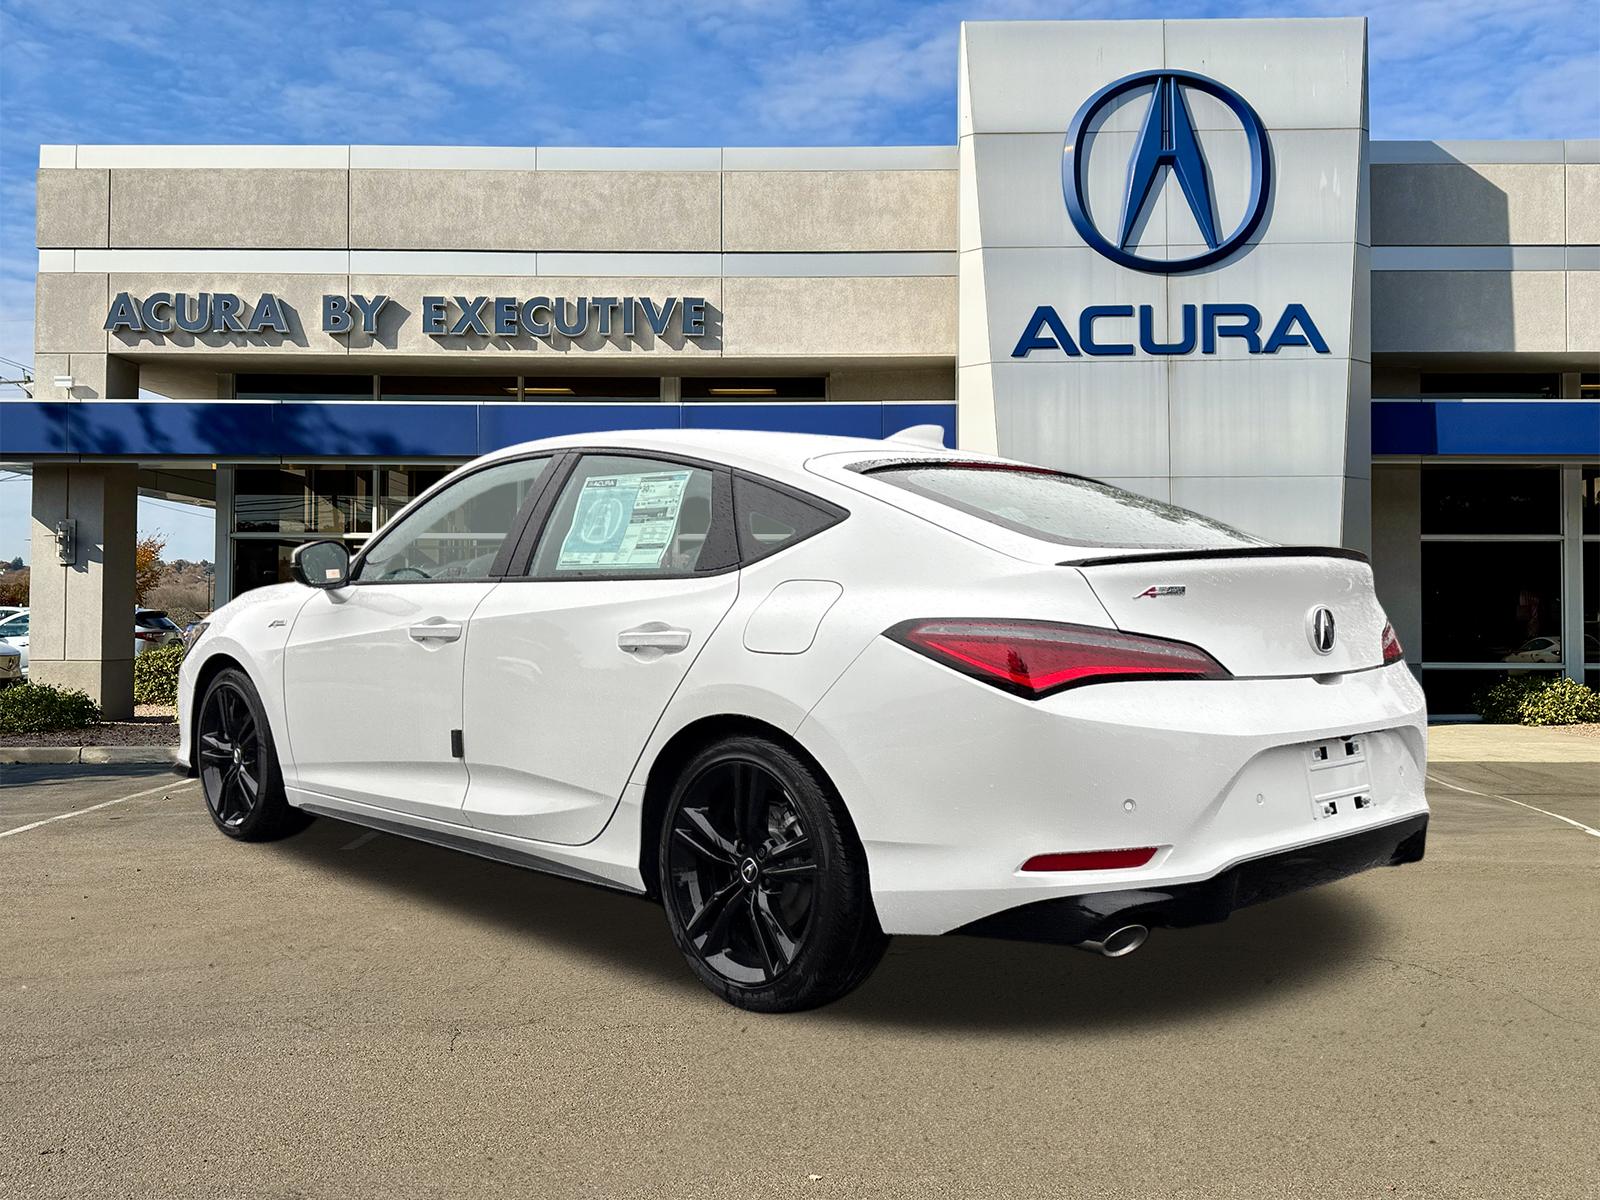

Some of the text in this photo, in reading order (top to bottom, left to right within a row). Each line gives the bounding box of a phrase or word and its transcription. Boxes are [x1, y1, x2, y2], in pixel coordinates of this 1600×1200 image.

[103, 292, 706, 337] ACURA BY EXECUTIVE
[1011, 303, 1332, 357] ACURA
[593, 479, 615, 487] ACURA
